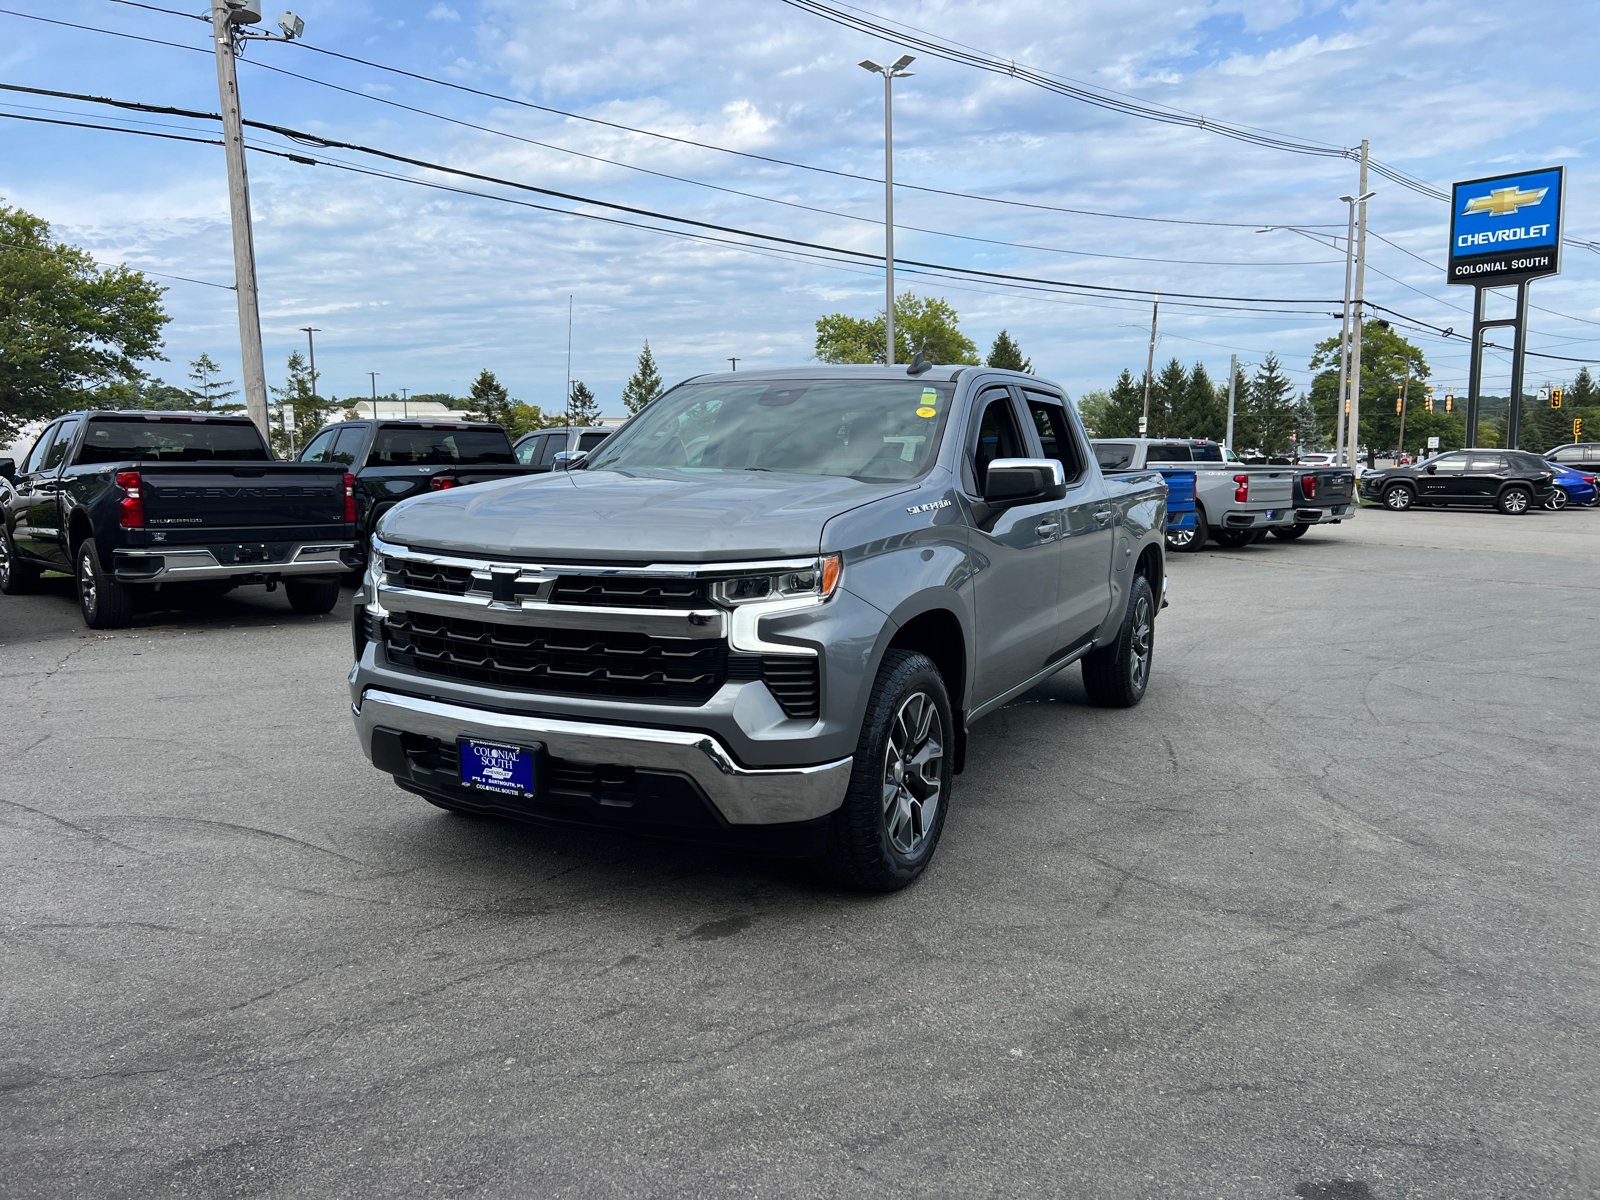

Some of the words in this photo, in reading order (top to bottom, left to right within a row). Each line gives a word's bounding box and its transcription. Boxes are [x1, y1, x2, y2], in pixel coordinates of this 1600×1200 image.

[1458, 224, 1550, 247] CHEVROLET
[1455, 261, 1508, 276] COLONIAL
[1511, 256, 1549, 269] SOUTH
[906, 499, 952, 515] SILVERADO
[473, 746, 520, 762] COLONIAL
[481, 756, 513, 770] SOUTH
[485, 769, 510, 777] CHEVROLET
[476, 784, 501, 793] COLONIAL
[501, 788, 519, 796] SOUTH
